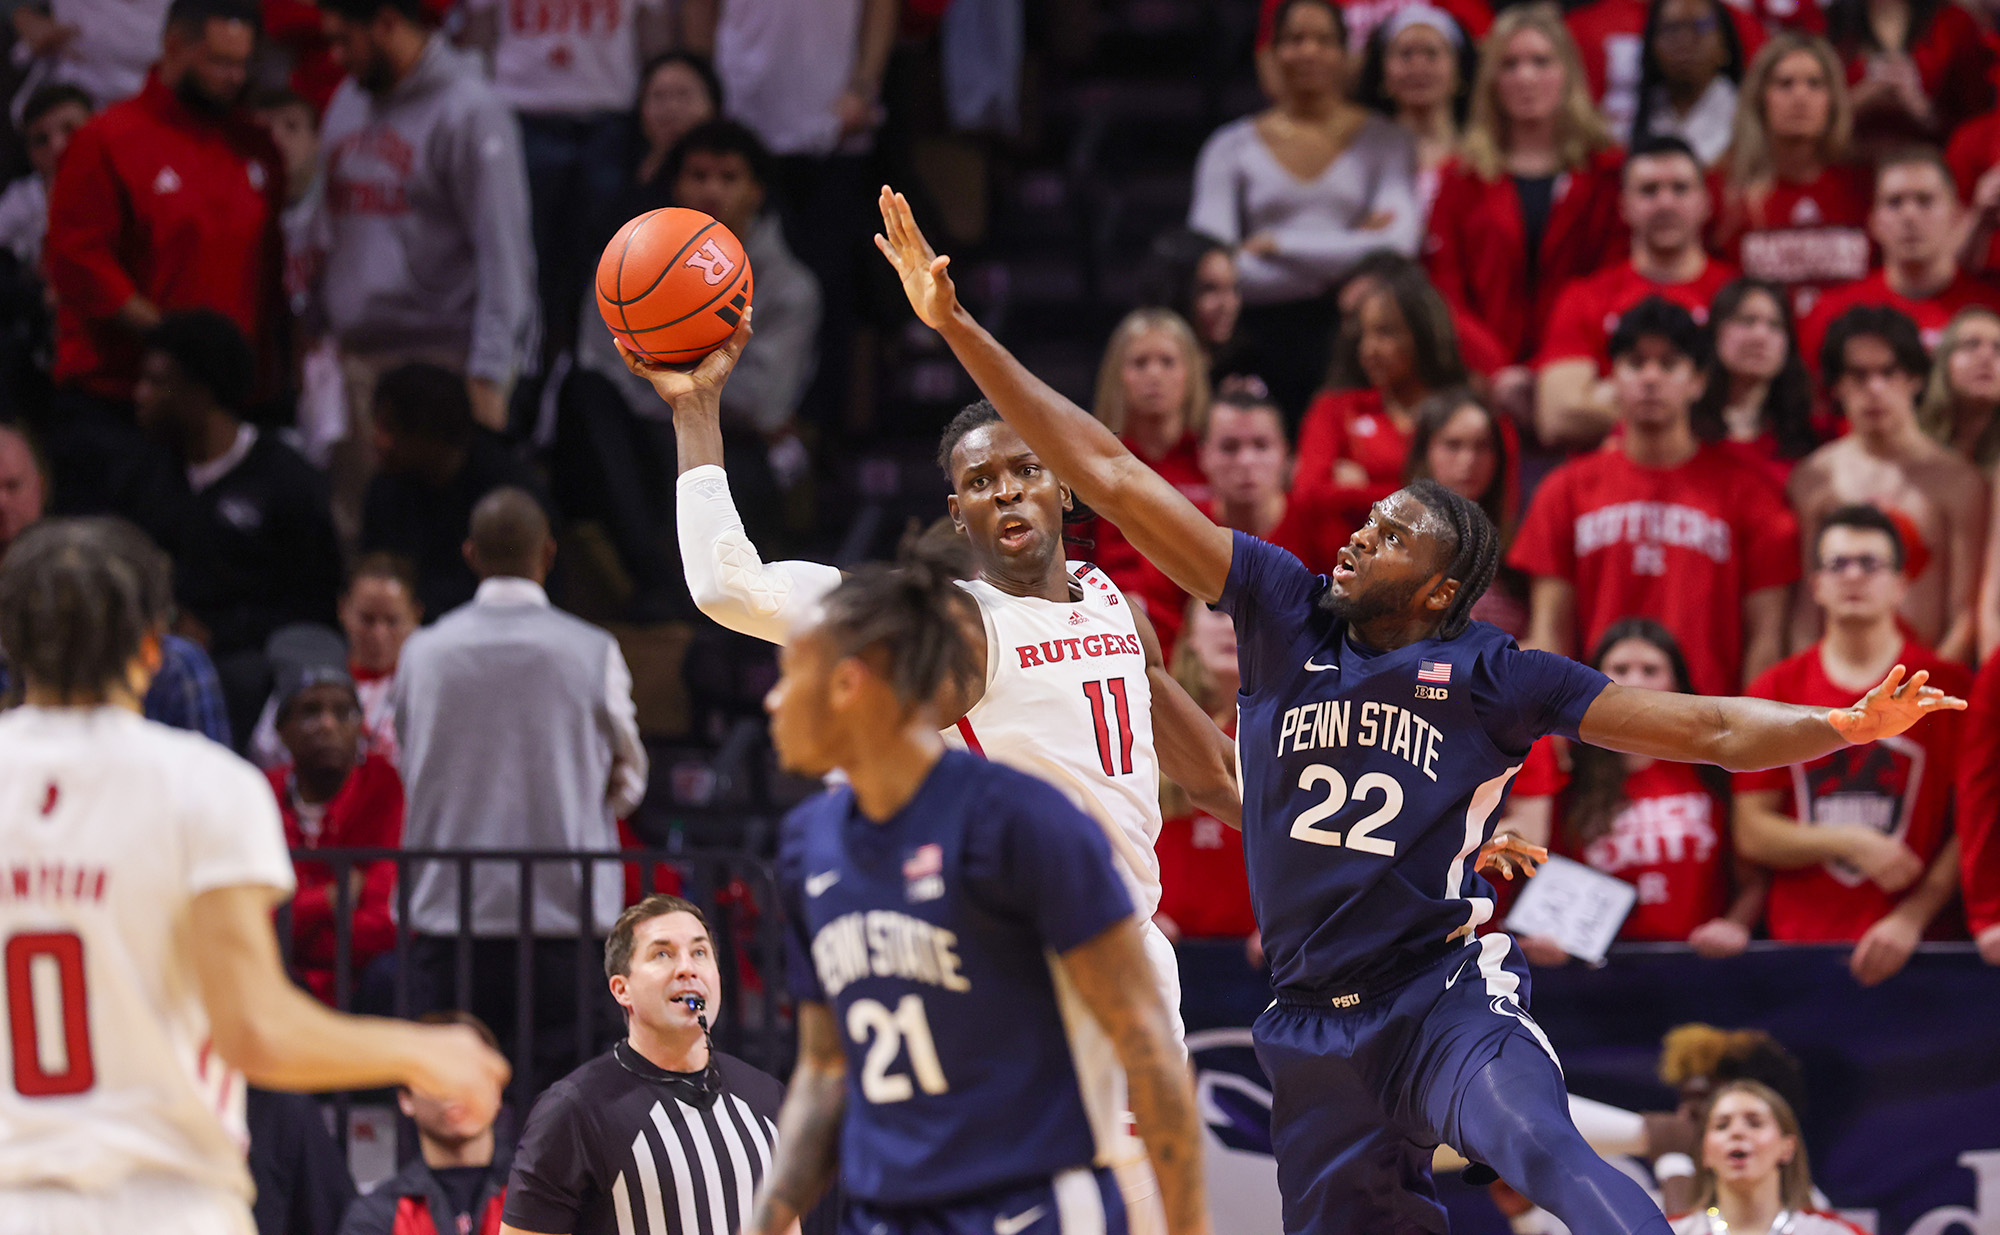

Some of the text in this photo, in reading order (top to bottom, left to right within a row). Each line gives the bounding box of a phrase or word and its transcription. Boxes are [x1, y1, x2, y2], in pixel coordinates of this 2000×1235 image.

[684, 237, 735, 287] R
[1016, 633, 1140, 669] RUTGERS
[1082, 677, 1134, 777] 11
[1277, 700, 1444, 783] PENN STATE
[1290, 763, 1404, 857] 22
[4, 930, 97, 1098] 0
[1331, 993, 1361, 1008] PSU
[846, 994, 949, 1105] 21
